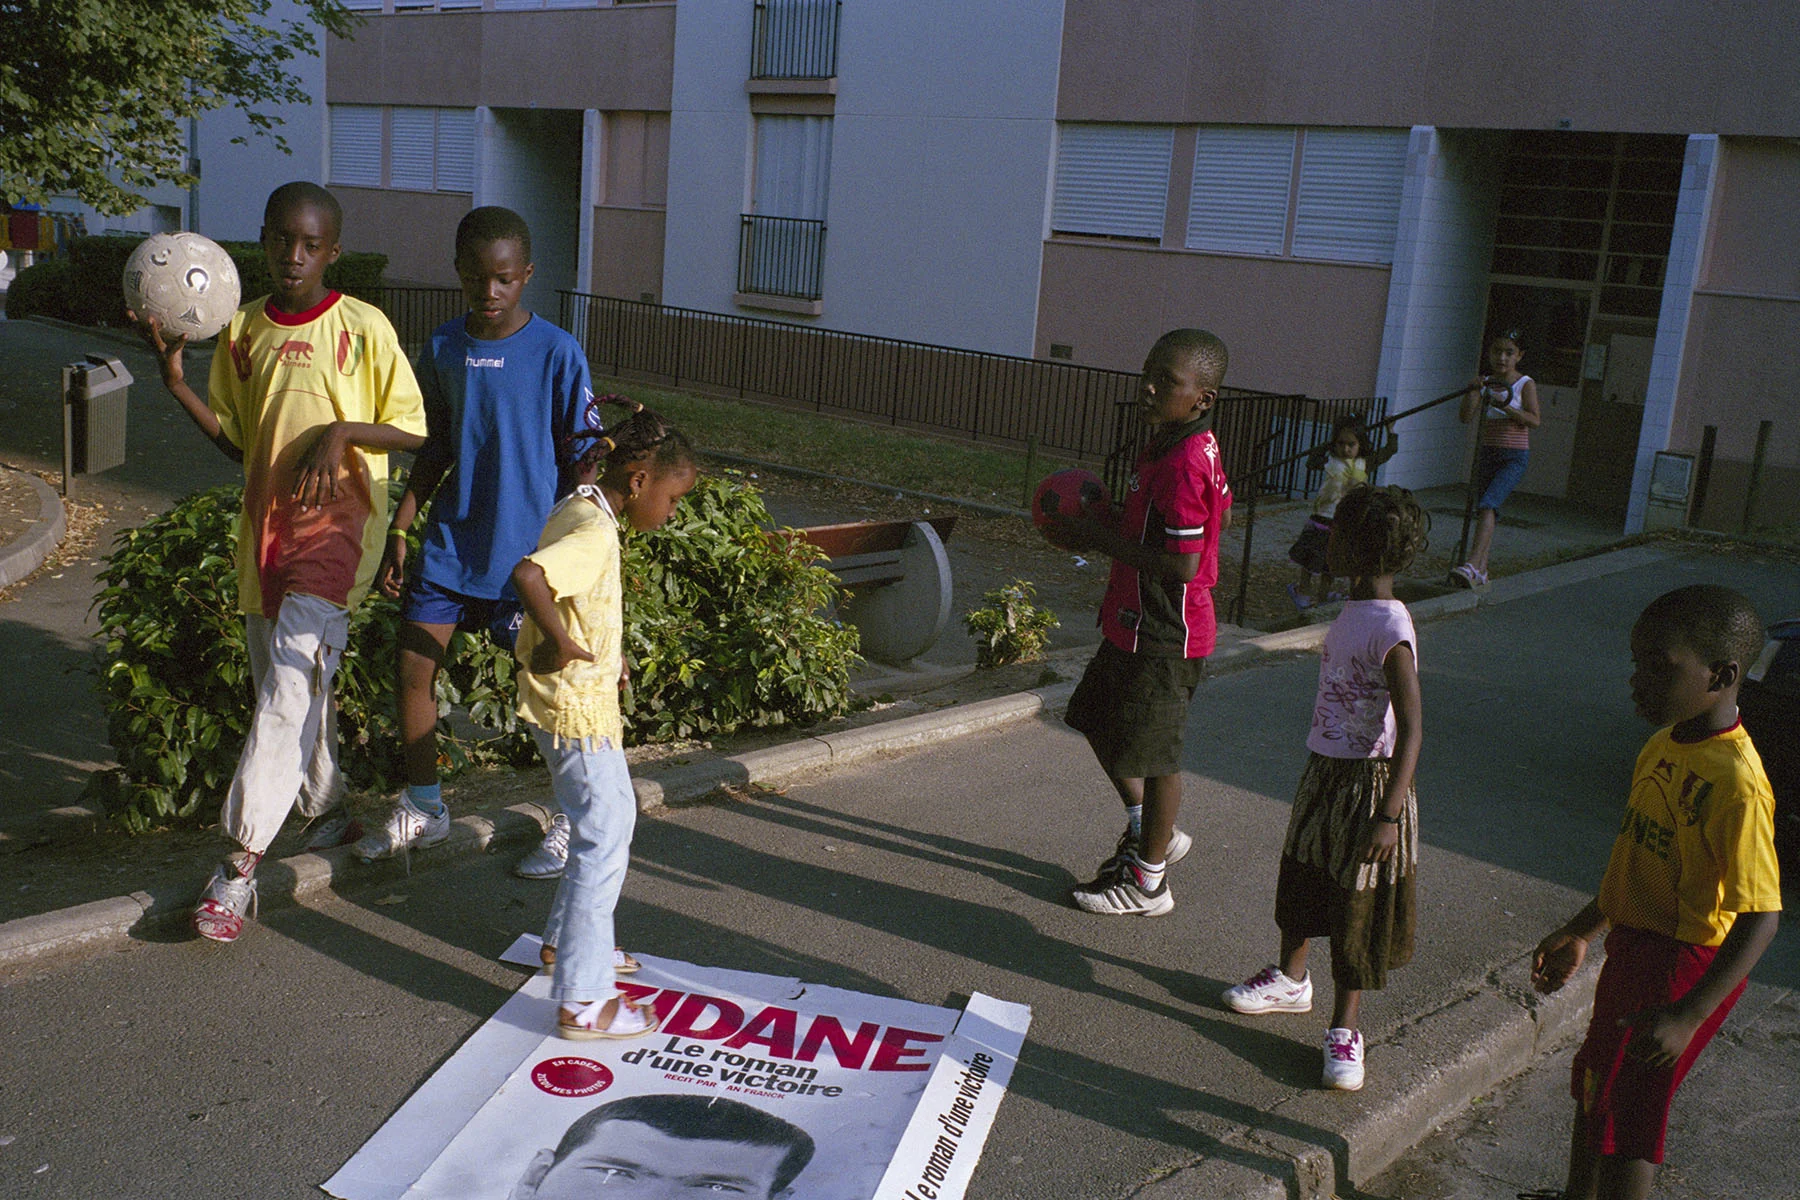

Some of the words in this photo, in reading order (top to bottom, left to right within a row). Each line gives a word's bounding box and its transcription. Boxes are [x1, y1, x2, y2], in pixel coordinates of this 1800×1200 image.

[465, 355, 505, 368] hummel
[551, 1060, 566, 1068] EN
[567, 1059, 603, 1073] CADEAU
[620, 1048, 714, 1078] d'une
[720, 1067, 843, 1098] victoire
[663, 1036, 705, 1056] Le
[709, 1049, 819, 1081] roman
[954, 1051, 994, 1101] victoire
[551, 1085, 572, 1095] MES
[573, 1080, 606, 1095] PHOTOS
[695, 1079, 718, 1088] PAR
[743, 1087, 786, 1100] FRANCK
[937, 1096, 975, 1139] d'une
[921, 1135, 959, 1190] roman
